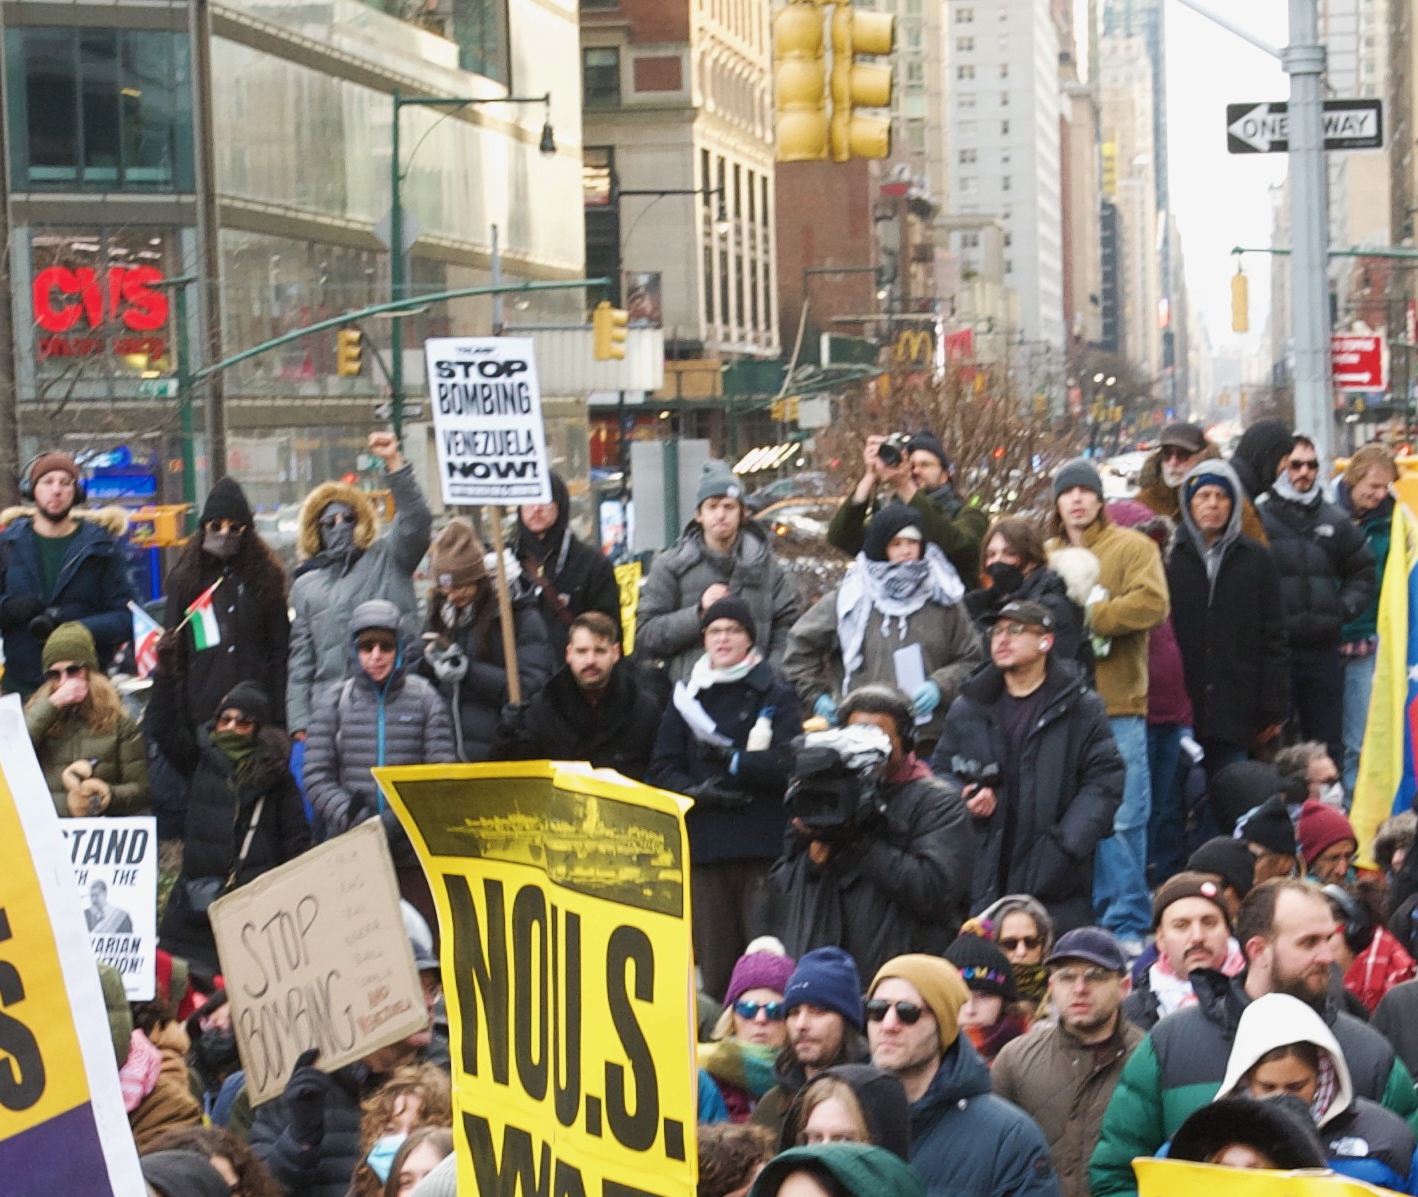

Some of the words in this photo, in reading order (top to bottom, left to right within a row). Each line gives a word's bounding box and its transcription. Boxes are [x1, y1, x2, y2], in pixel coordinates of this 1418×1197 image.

[1242, 112, 1287, 139] ONE
[1324, 111, 1368, 137] WAY
[33, 266, 169, 332] CVS
[435, 360, 529, 379] STOP
[438, 382, 532, 415] BOMBING
[443, 429, 536, 457] VENEZUELA
[447, 462, 539, 479] NOW!
[62, 829, 149, 865] TAND
[111, 868, 140, 887] THE
[91, 936, 142, 956] ARIAN
[241, 894, 320, 999] STOP
[239, 969, 356, 1094] BOMBING
[442, 873, 548, 1102] NO
[551, 904, 686, 1163] U.S.
